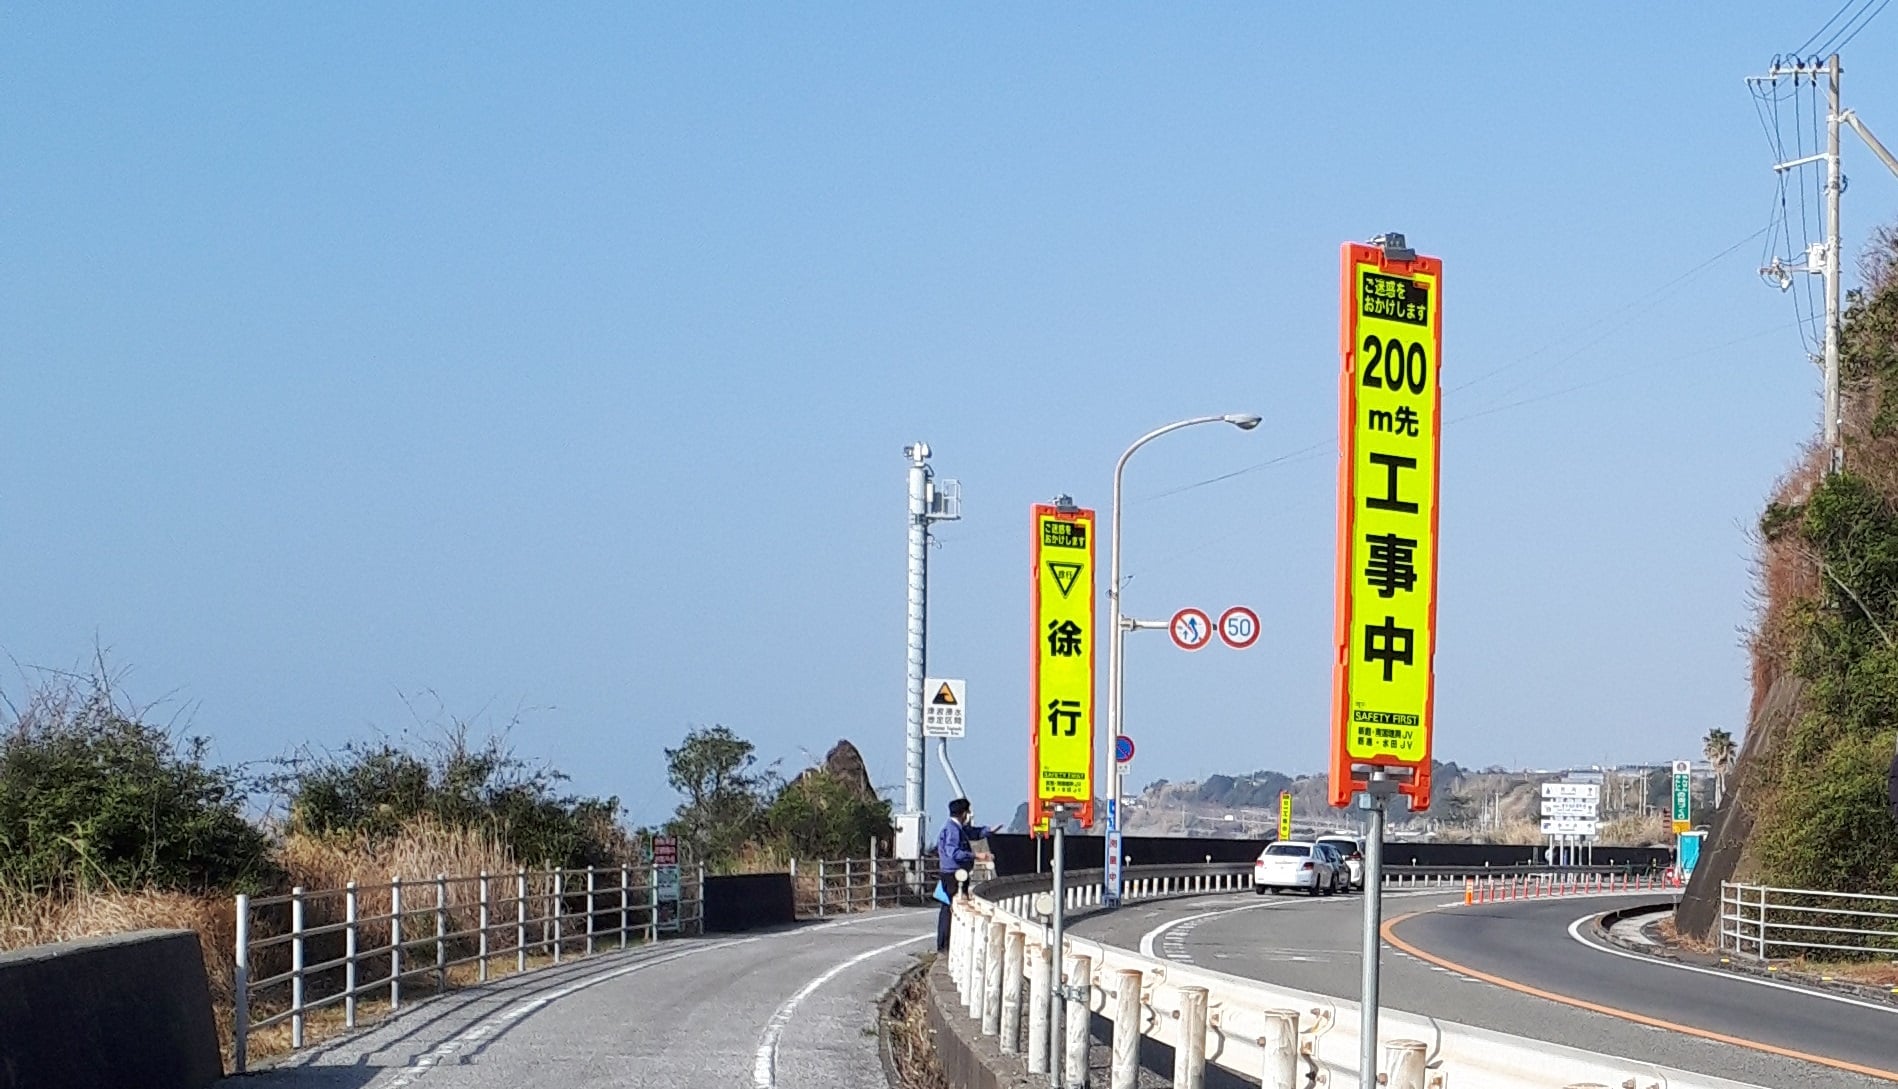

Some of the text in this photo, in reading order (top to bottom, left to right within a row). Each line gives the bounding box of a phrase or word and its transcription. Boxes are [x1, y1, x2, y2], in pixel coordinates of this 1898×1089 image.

[1364, 278, 1405, 300] ご迷惑を
[1364, 294, 1426, 321] おかけします
[1362, 334, 1427, 395] 200
[1368, 405, 1419, 438] m先
[1364, 452, 1419, 682] 工事中
[1228, 618, 1251, 637] 50
[1047, 618, 1083, 737] 徐行
[1355, 711, 1417, 725] SAFETY FIRST
